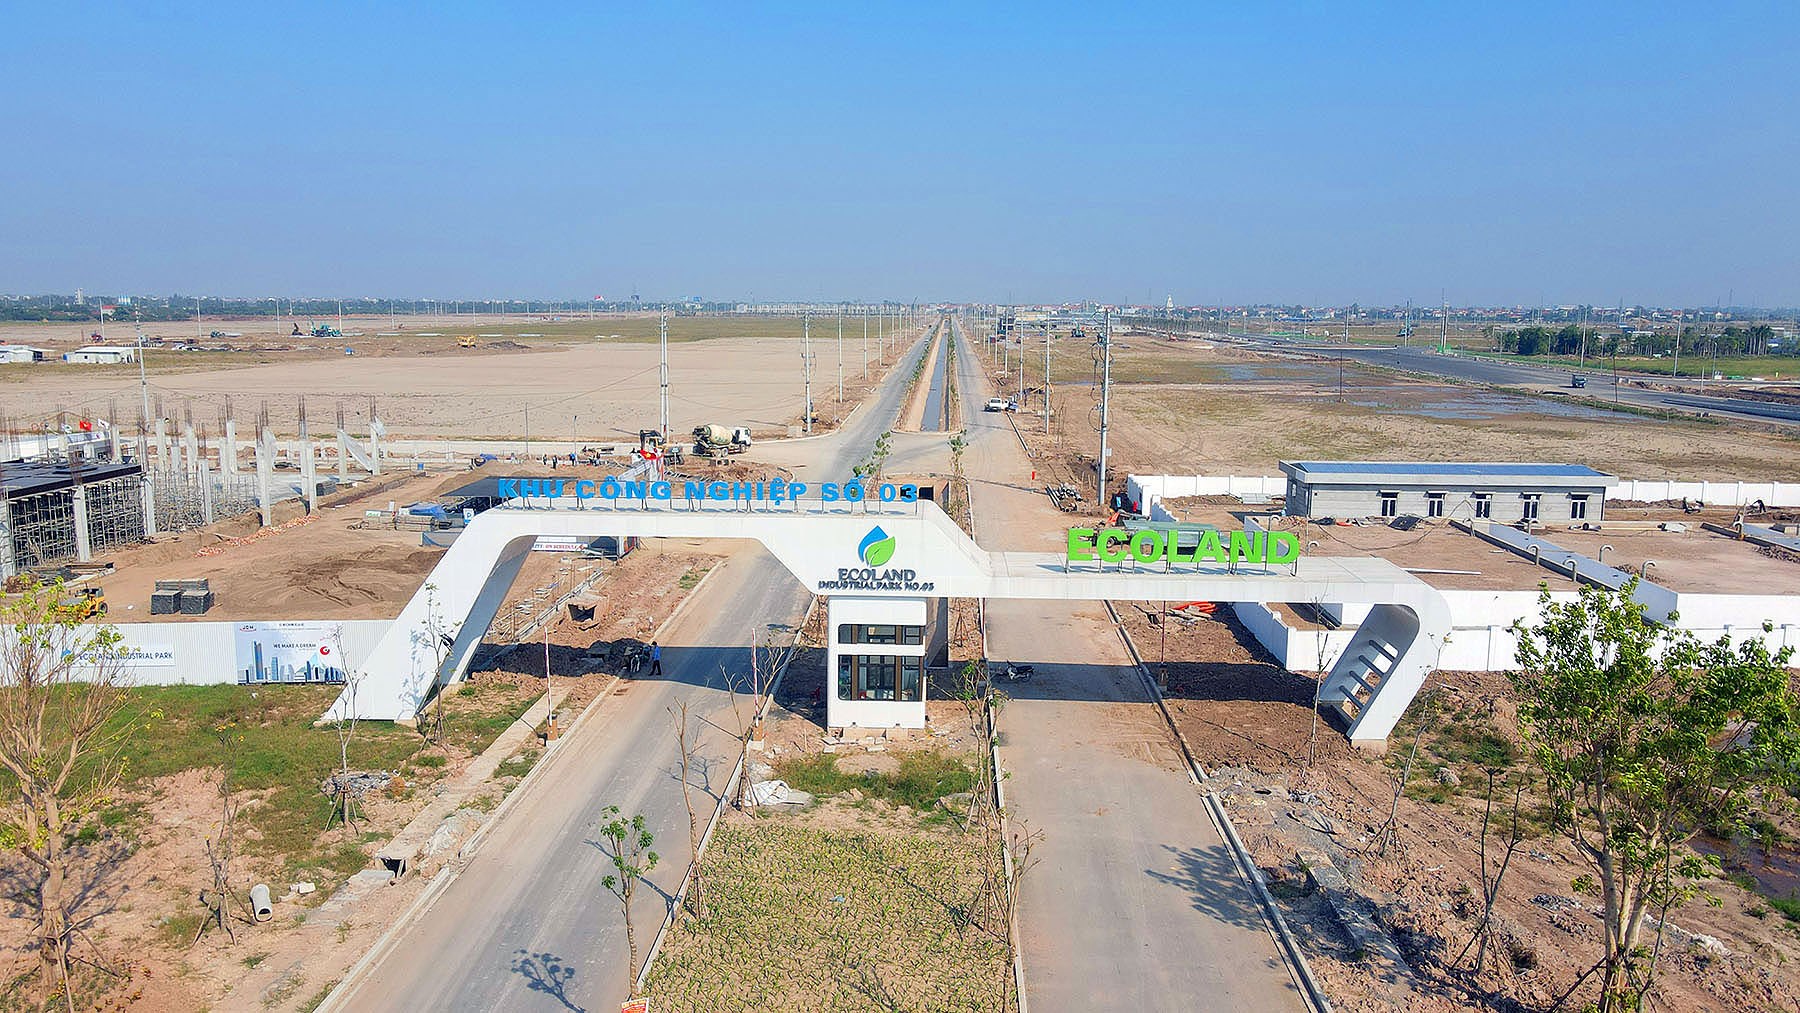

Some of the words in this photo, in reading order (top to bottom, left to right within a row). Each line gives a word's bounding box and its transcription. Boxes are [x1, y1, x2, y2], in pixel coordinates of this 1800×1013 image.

[498, 479, 564, 498] KHU
[575, 475, 672, 500] CÔNG
[684, 477, 807, 505] NGHIỆP
[822, 474, 865, 502] SỐ
[879, 483, 918, 502] 03
[1067, 528, 1301, 564] ECOLAND
[837, 568, 917, 581] ECOLAND
[818, 580, 876, 590] INDUSTRIAL
[876, 581, 902, 591] PARK
[80, 652, 114, 660] ECOLA
[155, 652, 173, 660] PARK
